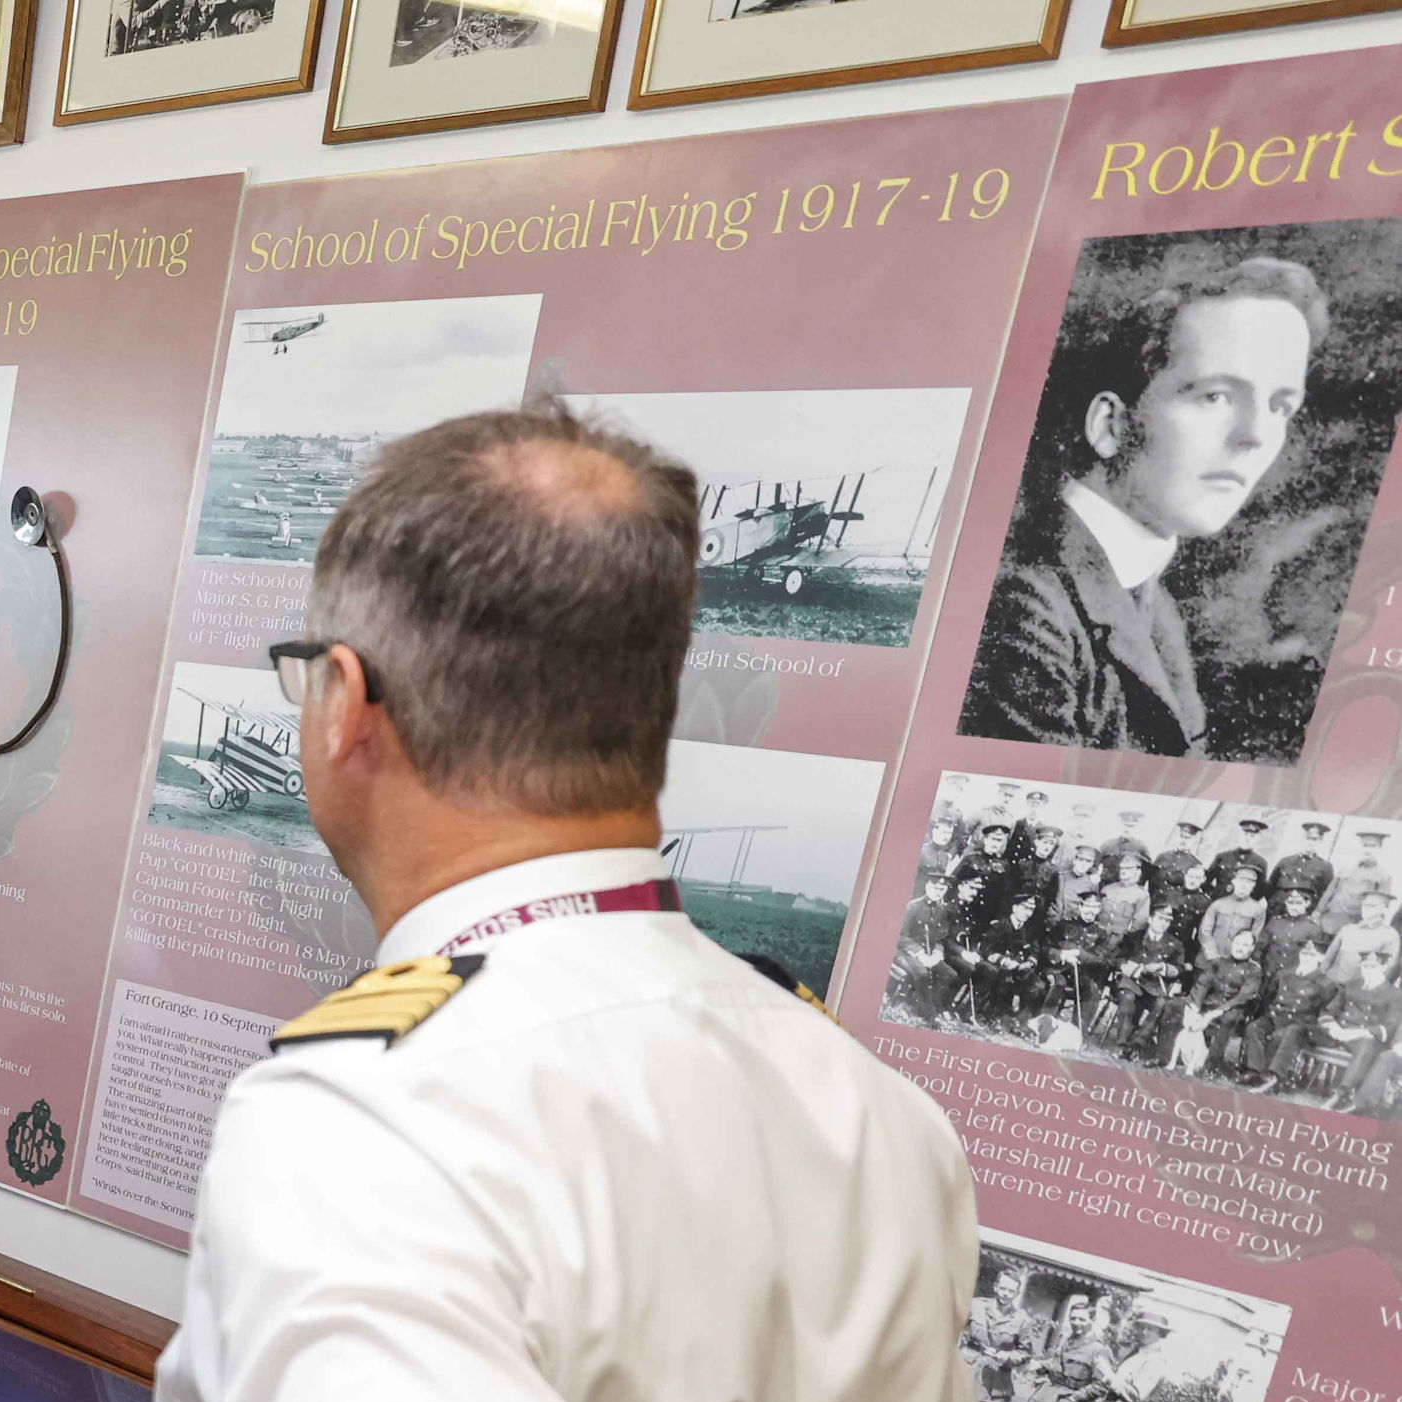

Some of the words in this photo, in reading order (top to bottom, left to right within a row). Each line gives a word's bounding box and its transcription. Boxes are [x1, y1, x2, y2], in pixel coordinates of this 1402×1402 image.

[1091, 120, 1357, 200] Robert
[89, 228, 192, 276] Flying
[246, 218, 376, 274] School
[384, 213, 432, 263] of
[433, 198, 595, 270] Special
[600, 186, 757, 258] Flying
[196, 590, 237, 606] Major
[240, 592, 252, 607] S.
[257, 594, 270, 608] G.
[200, 569, 227, 584] The
[232, 572, 285, 588] School
[288, 574, 307, 590] of
[189, 629, 206, 642] of
[224, 631, 260, 650] flight
[192, 609, 232, 628] flying
[235, 612, 258, 628] the
[735, 652, 814, 675] School
[819, 656, 844, 677] of
[140, 852, 166, 870] Pup
[249, 872, 272, 889] the
[276, 877, 329, 901] aircraft
[332, 887, 352, 905] of
[143, 833, 181, 852] Black
[184, 841, 213, 858] and
[213, 845, 256, 866] white
[259, 854, 325, 879] stripped
[132, 890, 224, 920] Commander
[247, 912, 287, 934] flight.
[136, 871, 189, 893] Captain
[192, 882, 235, 901] Foote
[237, 892, 274, 911] RFC.
[280, 899, 323, 921] Flight
[124, 926, 166, 949] killing
[167, 936, 191, 953] the
[192, 943, 225, 960] pilot
[227, 949, 275, 972] (name
[278, 962, 348, 988] unkown)
[205, 925, 267, 950] crashed
[269, 940, 290, 955] on
[295, 943, 313, 960] 18
[316, 948, 350, 969] May
[355, 956, 376, 971] 19
[125, 989, 149, 1005] Fort
[203, 1009, 219, 1022] 10
[221, 1014, 276, 1037] Septem
[874, 1035, 920, 1061] The
[924, 1047, 981, 1076] First
[987, 1060, 1084, 1097] Course
[1090, 1083, 1118, 1105] at
[1122, 1088, 1167, 1113] the
[1174, 1099, 1285, 1139] Central
[1289, 1122, 1394, 1165] Flying
[958, 1080, 1066, 1121] Upavon.
[1078, 1107, 1253, 1164] Smith-Barry
[1259, 1144, 1285, 1168] is
[1292, 1150, 1388, 1191] fourth
[967, 1107, 1006, 1134] left
[1011, 1122, 1097, 1155] centre
[1103, 1143, 1161, 1168] row
[1165, 1157, 1225, 1185] and
[1230, 1167, 1321, 1205] Major
[123, 1189, 143, 1202] over
[145, 1196, 158, 1206] the
[959, 1134, 1071, 1177] Marshall
[1076, 1162, 1146, 1195] Lord
[1153, 1179, 1323, 1236] Trenchard)
[970, 1165, 1062, 1201] xtreme
[1067, 1189, 1132, 1219] right
[1137, 1206, 1230, 1243] centre
[1237, 1231, 1302, 1261] row.
